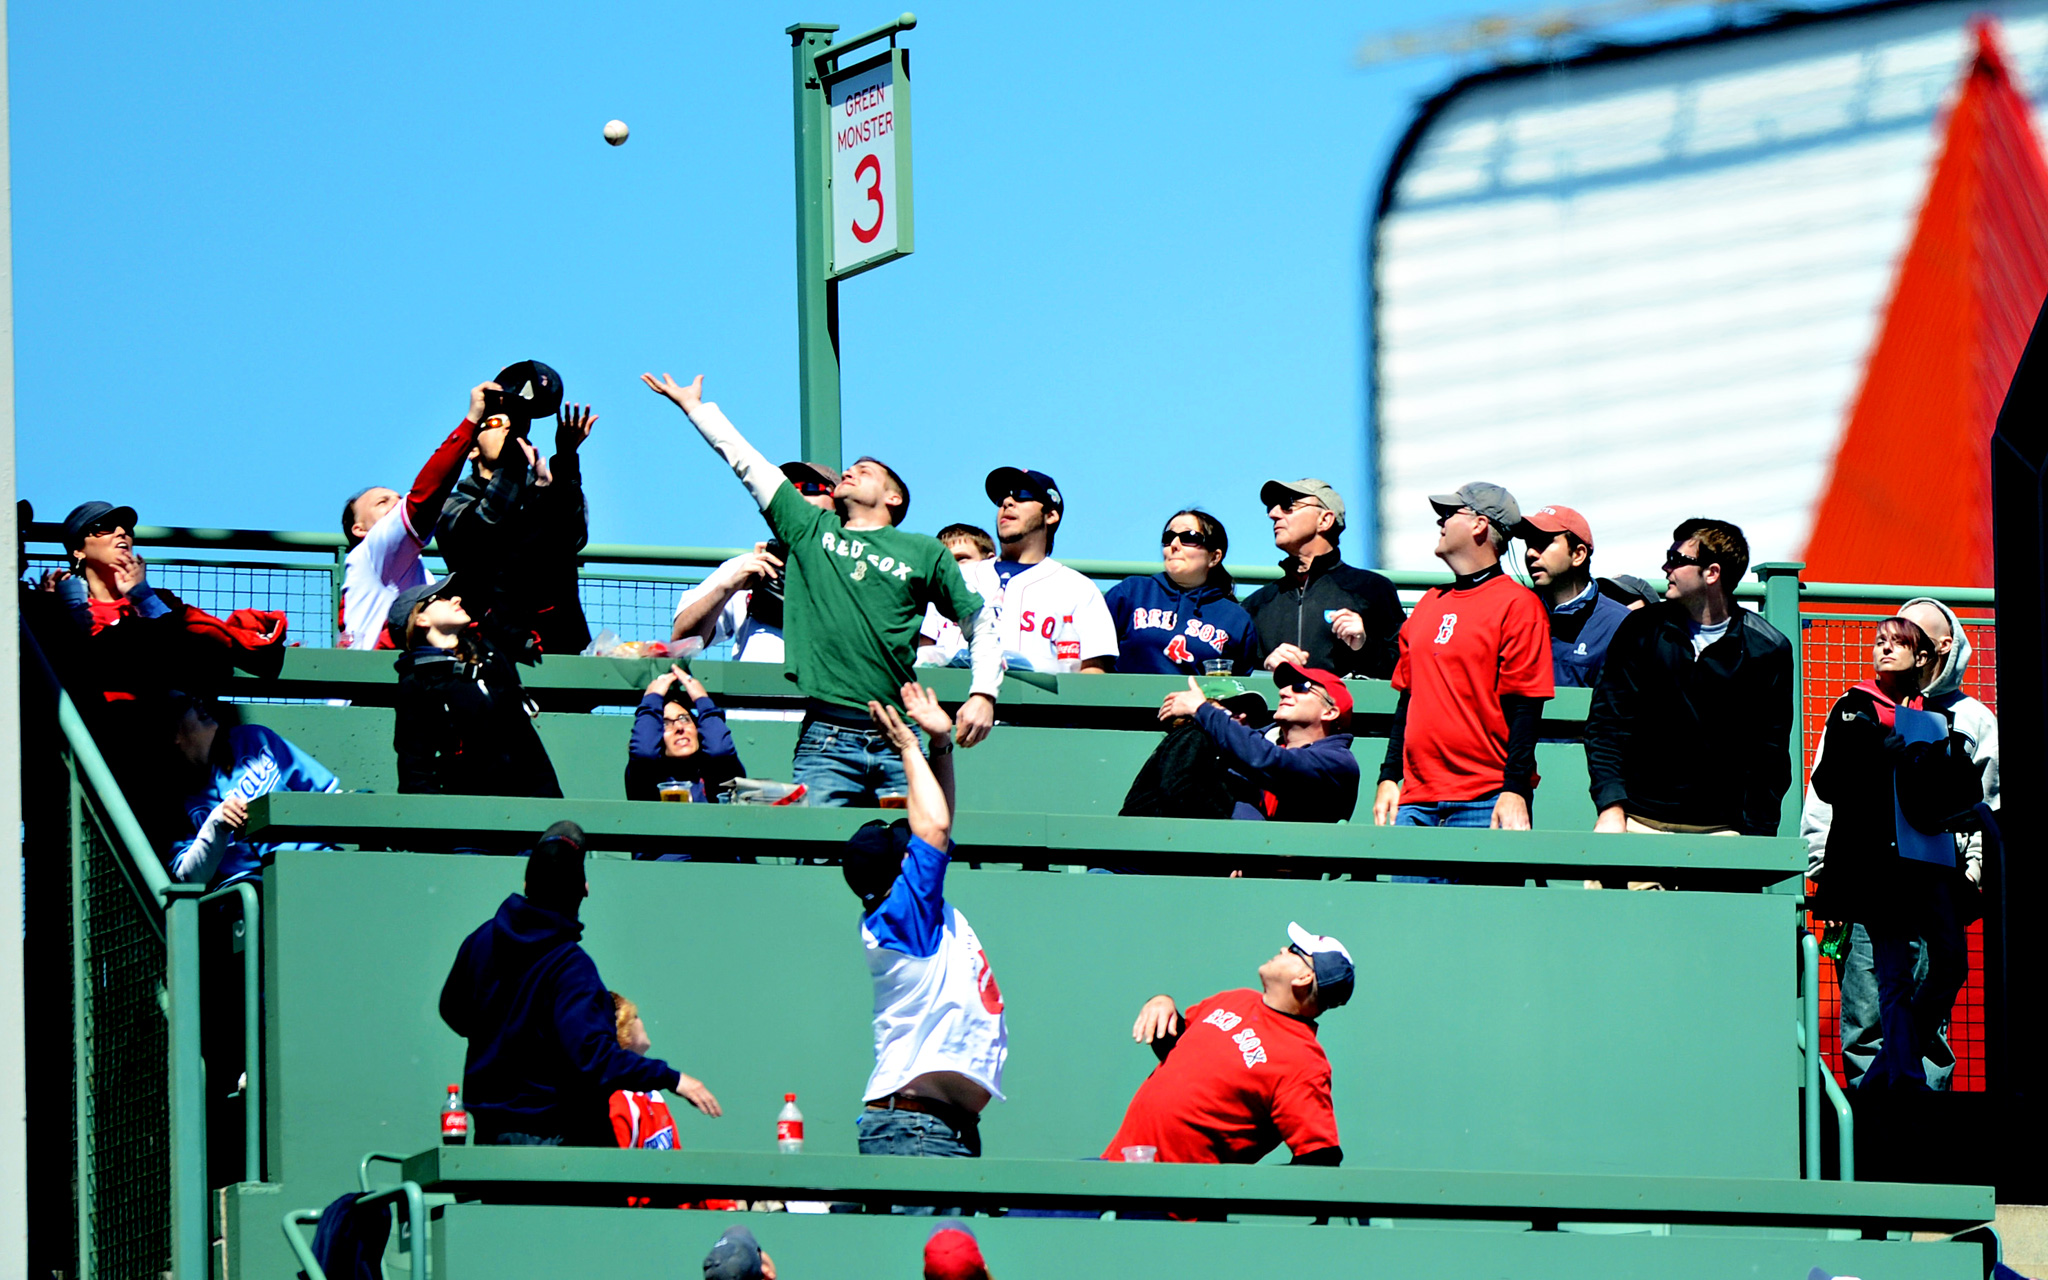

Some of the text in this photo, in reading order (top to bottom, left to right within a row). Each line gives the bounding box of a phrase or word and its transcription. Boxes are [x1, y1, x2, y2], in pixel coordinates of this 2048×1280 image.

[845, 82, 885, 116] GREEN
[838, 111, 893, 151] MONSTER
[851, 153, 885, 244] 3
[822, 532, 863, 559] RED
[1020, 610, 1057, 645] SO
[1184, 618, 1229, 655] SOX
[1433, 613, 1458, 645] B
[1202, 1008, 1268, 1069] RED SOX
